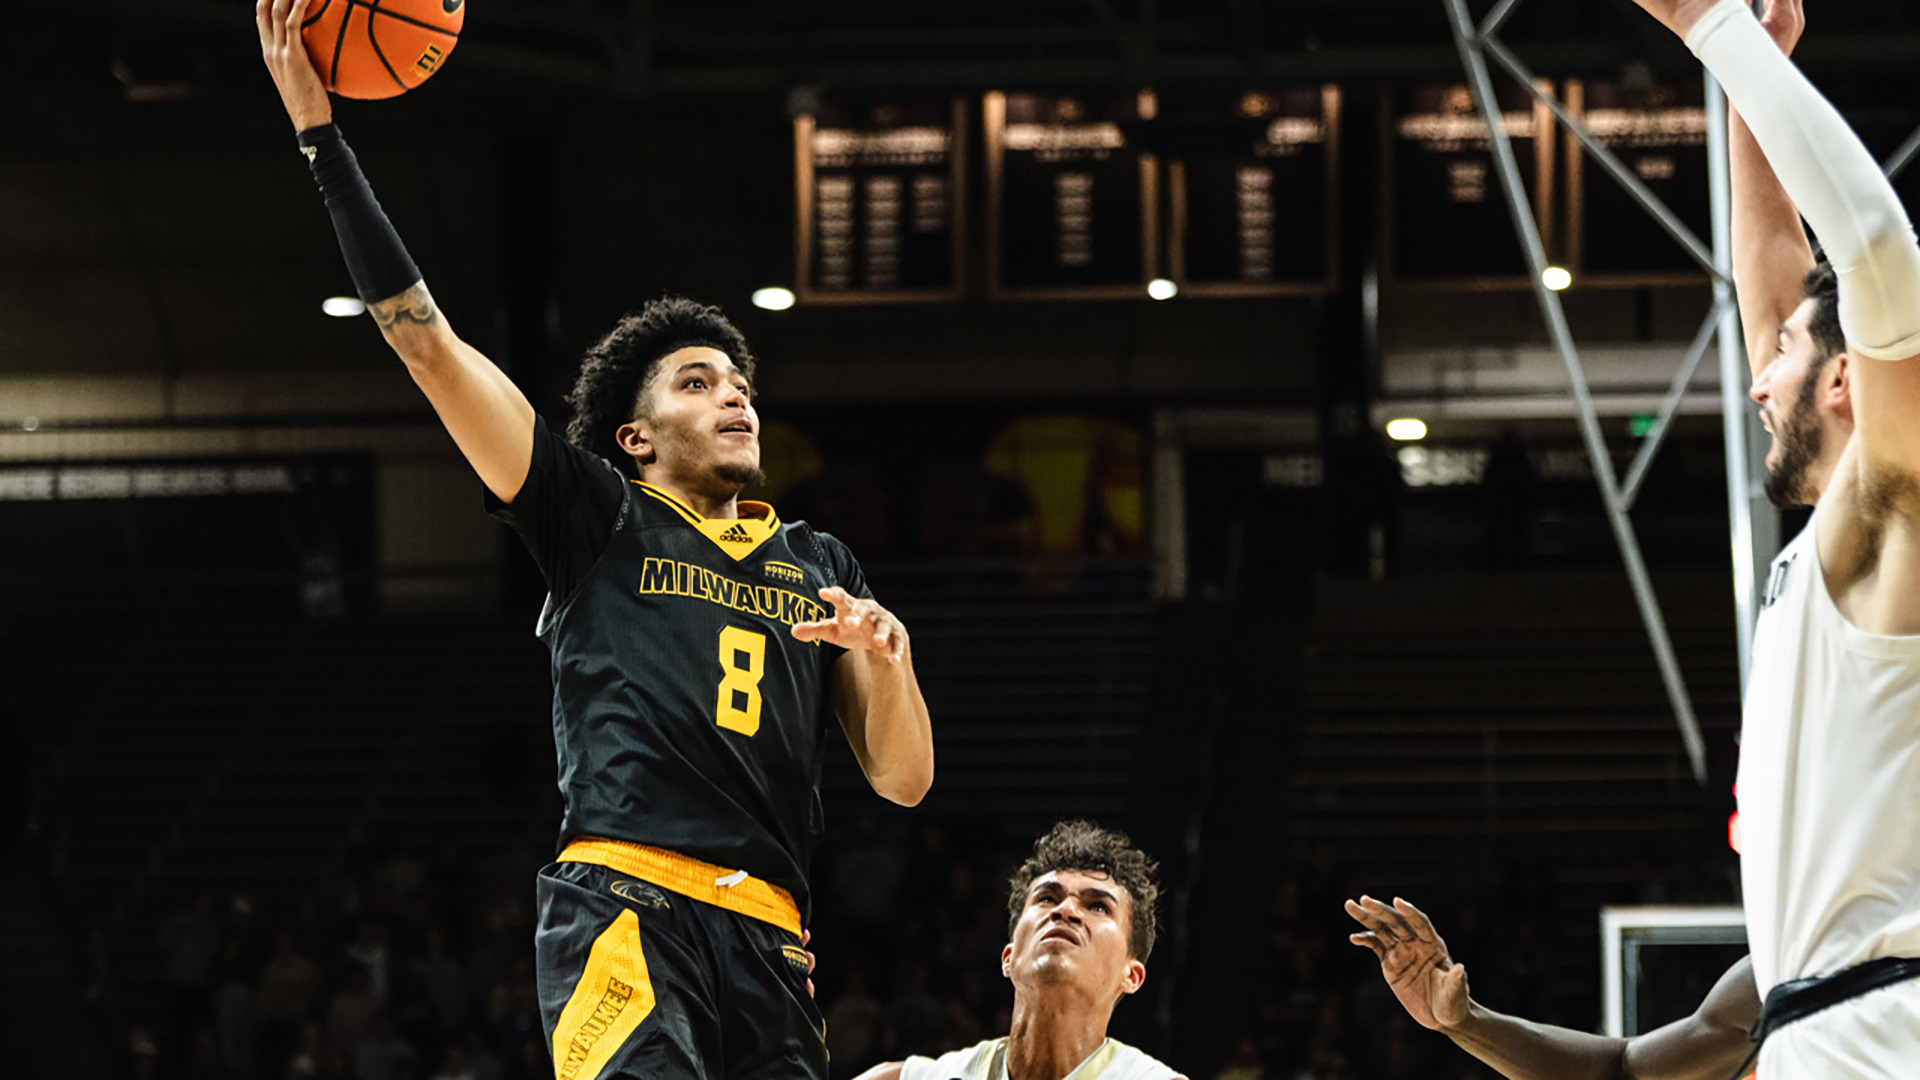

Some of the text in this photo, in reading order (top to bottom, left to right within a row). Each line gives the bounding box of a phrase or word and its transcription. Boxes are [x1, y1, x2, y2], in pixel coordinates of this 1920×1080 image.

[720, 533, 753, 543] adidas
[716, 625, 766, 737] 8
[560, 976, 633, 1080] LWAUKEE
